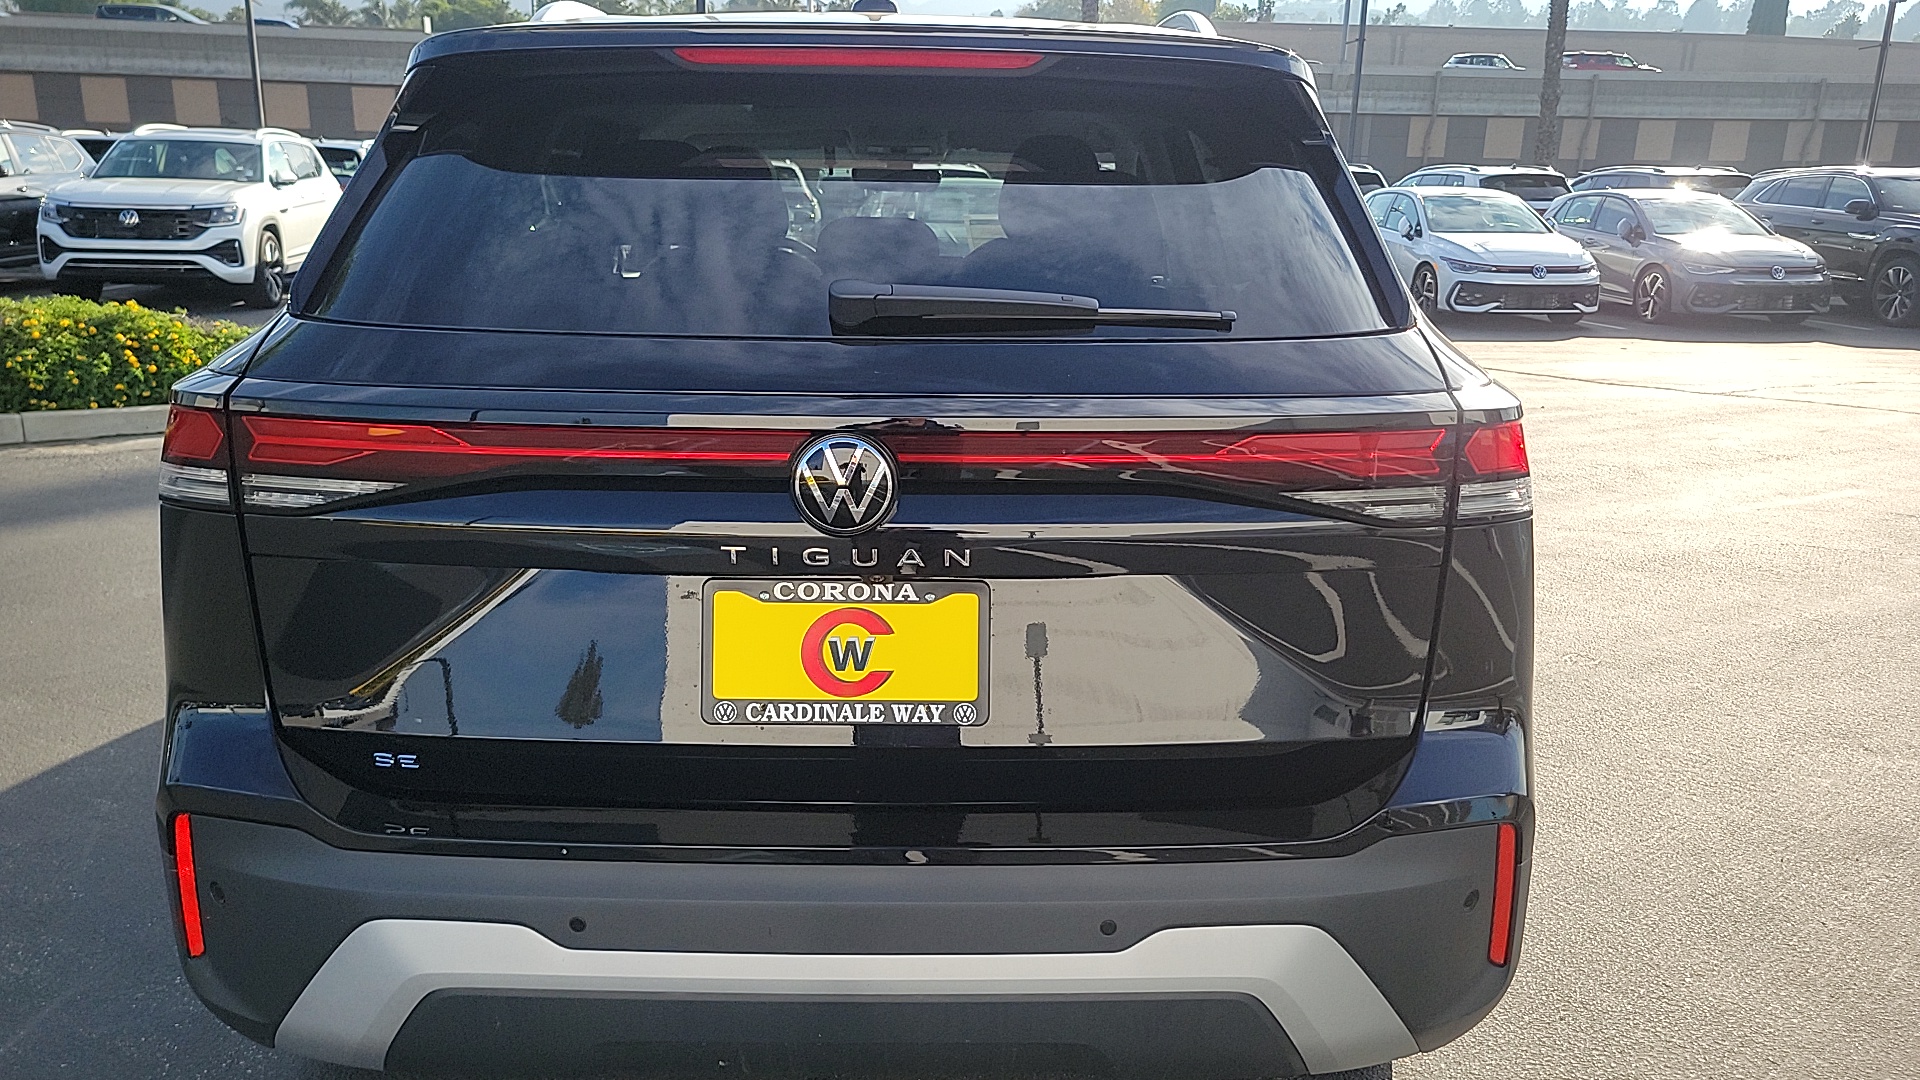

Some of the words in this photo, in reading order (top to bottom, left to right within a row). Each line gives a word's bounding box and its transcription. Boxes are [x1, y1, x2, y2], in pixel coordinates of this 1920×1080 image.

[794, 434, 897, 534] VW
[720, 545, 971, 568] TIGUAN
[773, 582, 920, 602] CORONA
[745, 702, 886, 724] CARDINALE
[890, 704, 946, 724] WAY
[373, 752, 420, 769] SE
